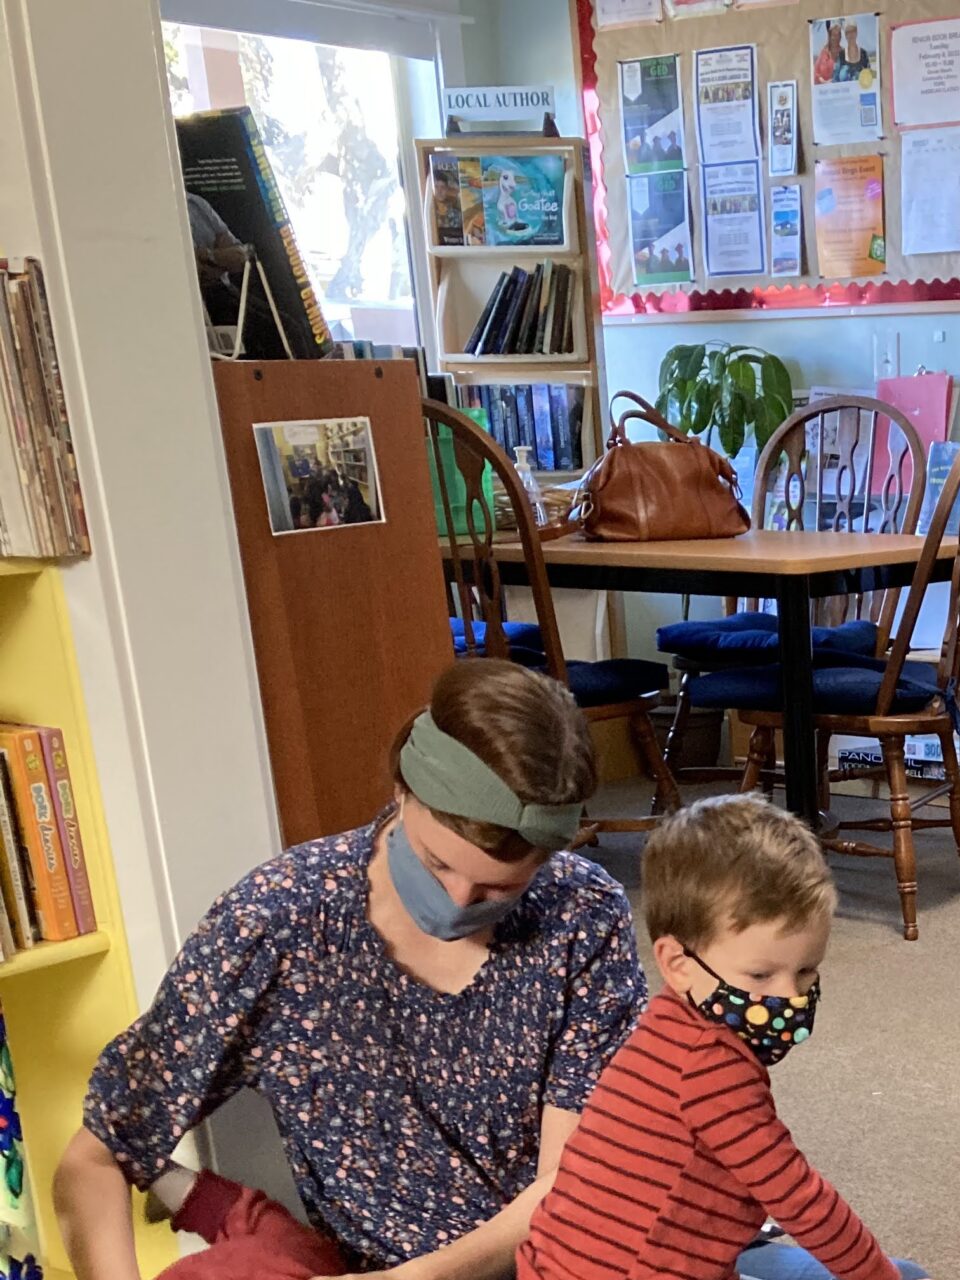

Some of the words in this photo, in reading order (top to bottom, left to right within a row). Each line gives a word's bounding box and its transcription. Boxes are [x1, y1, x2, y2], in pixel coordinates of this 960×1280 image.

[447, 93, 491, 109] LOCAL
[495, 91, 551, 108] AUTHOR
[280, 226, 309, 283] BLOODY
[301, 287, 329, 345] GENIUS
[32, 784, 49, 821] DORK
[58, 781, 72, 817] DORK
[65, 820, 80, 868] diaries
[40, 824, 56, 872] diaries
